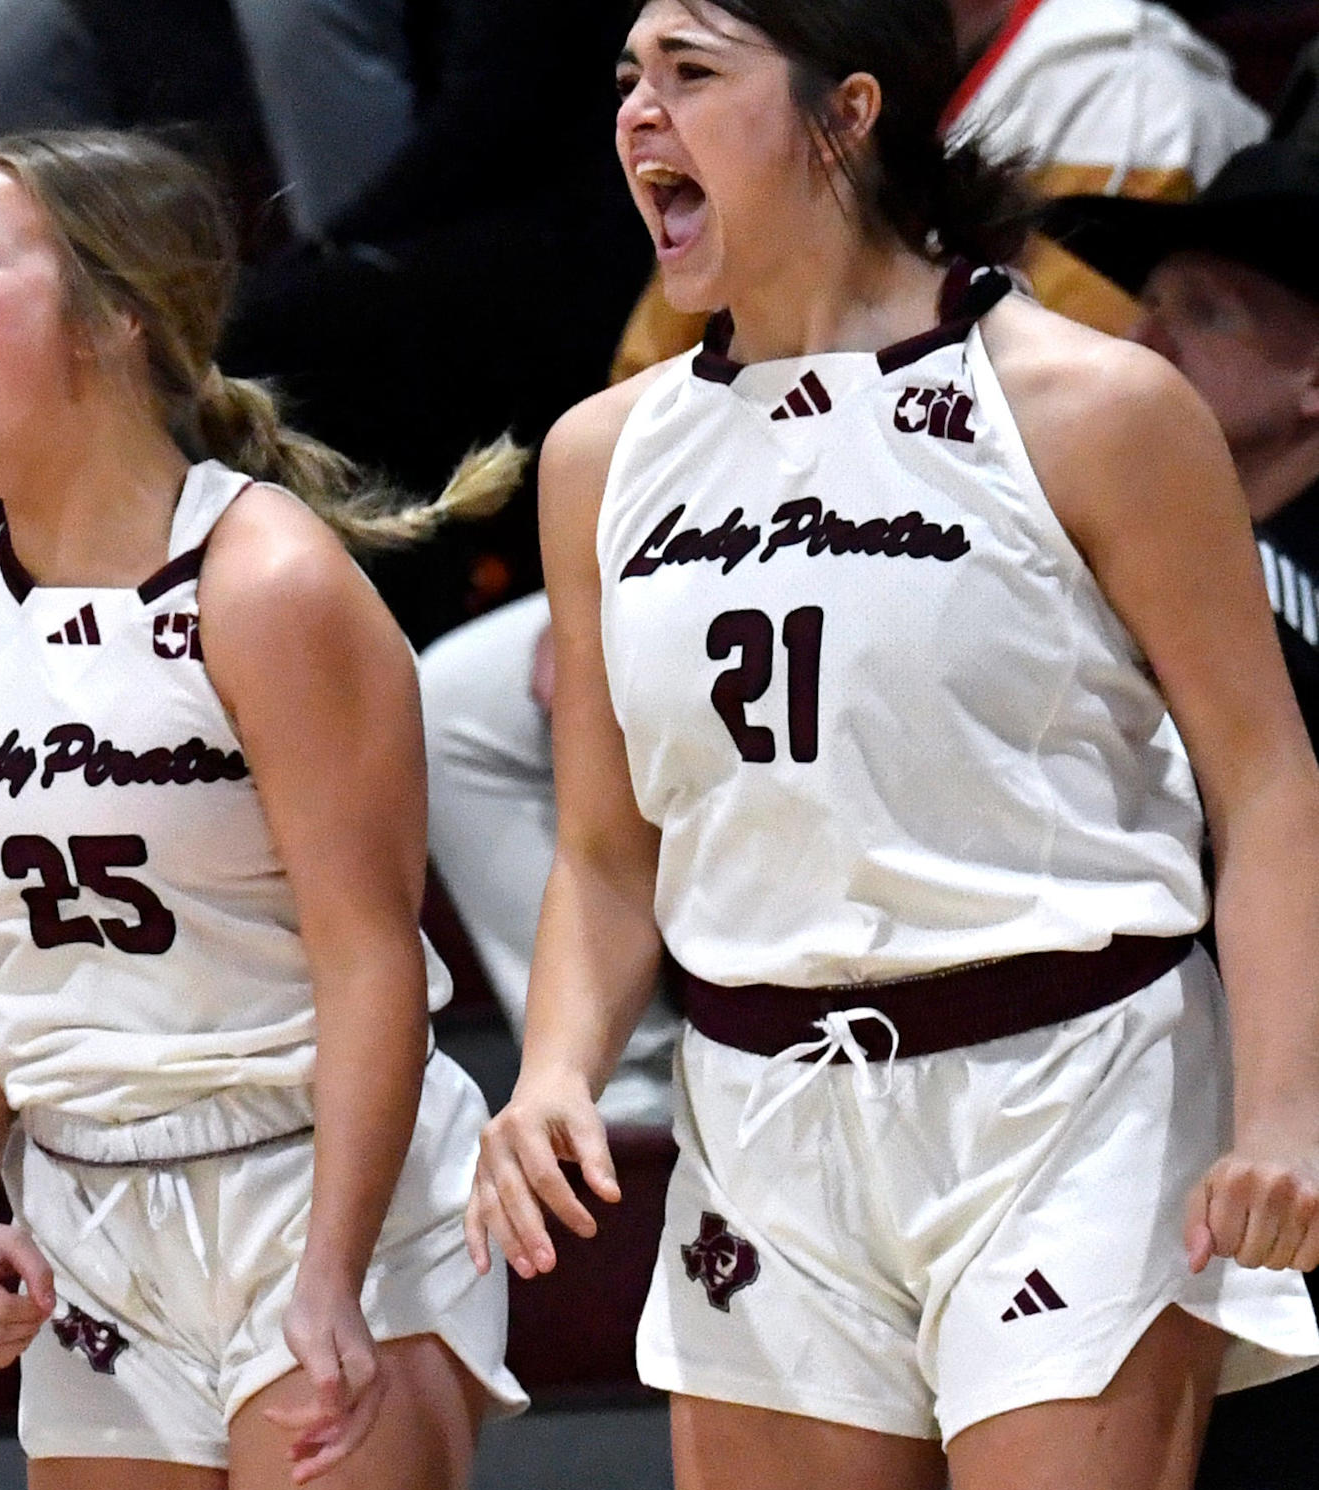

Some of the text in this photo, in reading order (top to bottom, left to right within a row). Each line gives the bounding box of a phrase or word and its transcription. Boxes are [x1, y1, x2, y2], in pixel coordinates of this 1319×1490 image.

[619, 496, 972, 583] Lady Pirates
[705, 605, 824, 763] 21
[40, 722, 250, 789] Pirates
[1, 834, 176, 955] 25
